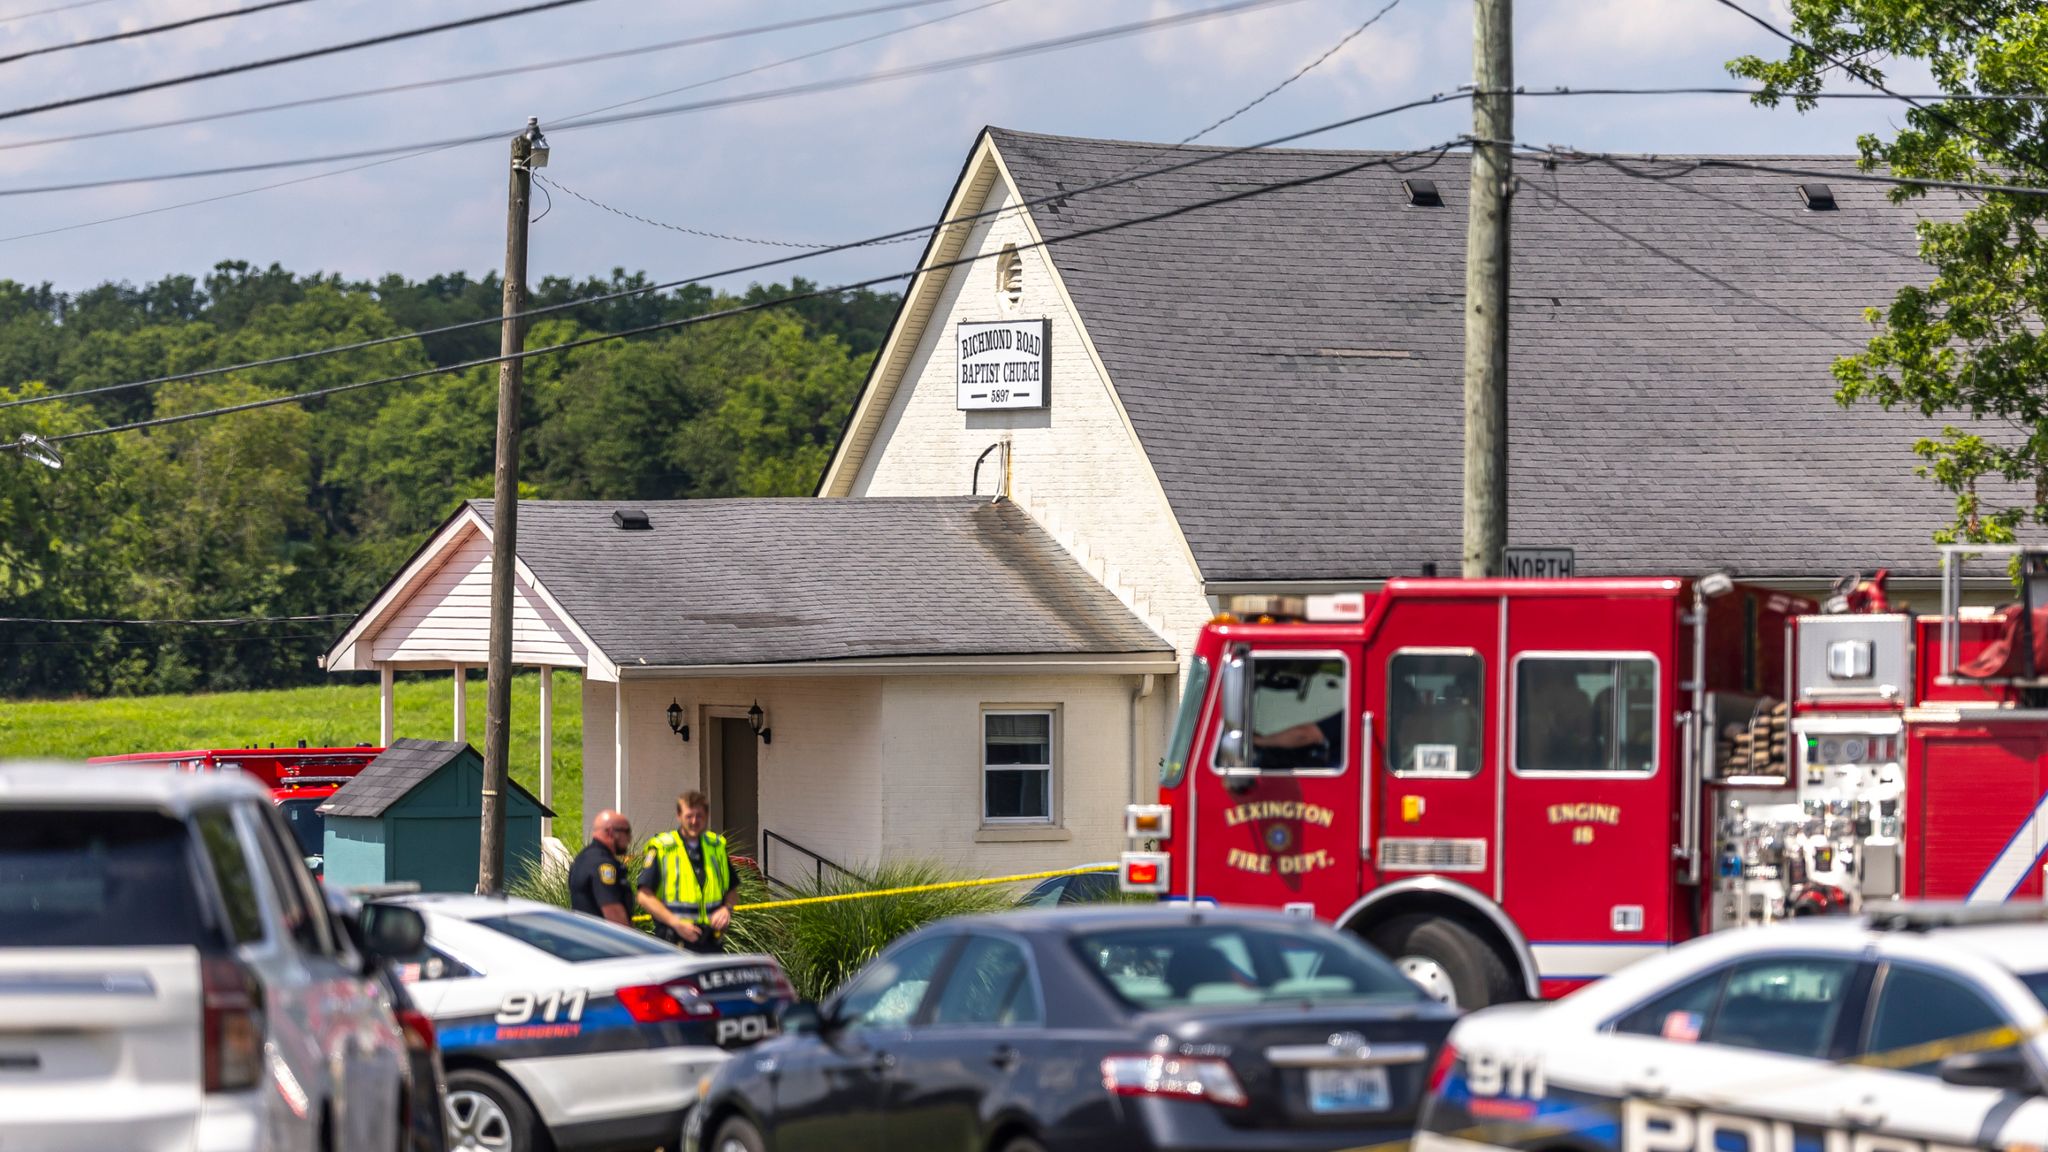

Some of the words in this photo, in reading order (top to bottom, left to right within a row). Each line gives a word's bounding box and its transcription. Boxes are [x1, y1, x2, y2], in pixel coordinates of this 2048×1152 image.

[961, 329, 1012, 359] RICHMOND
[1016, 330, 1040, 356] ROAD
[961, 363, 1000, 384] BAPTIST
[1003, 361, 1039, 382] CHURCH
[991, 389, 1010, 402] 5897
[1507, 556, 1570, 578] NORTH
[1224, 800, 1334, 828] LEXINGTON
[1547, 801, 1621, 826] ENGINE
[1227, 847, 1272, 874] FIRE
[1278, 848, 1335, 874] DEPT.
[495, 986, 588, 1024] 911
[1465, 1047, 1546, 1100] 911
